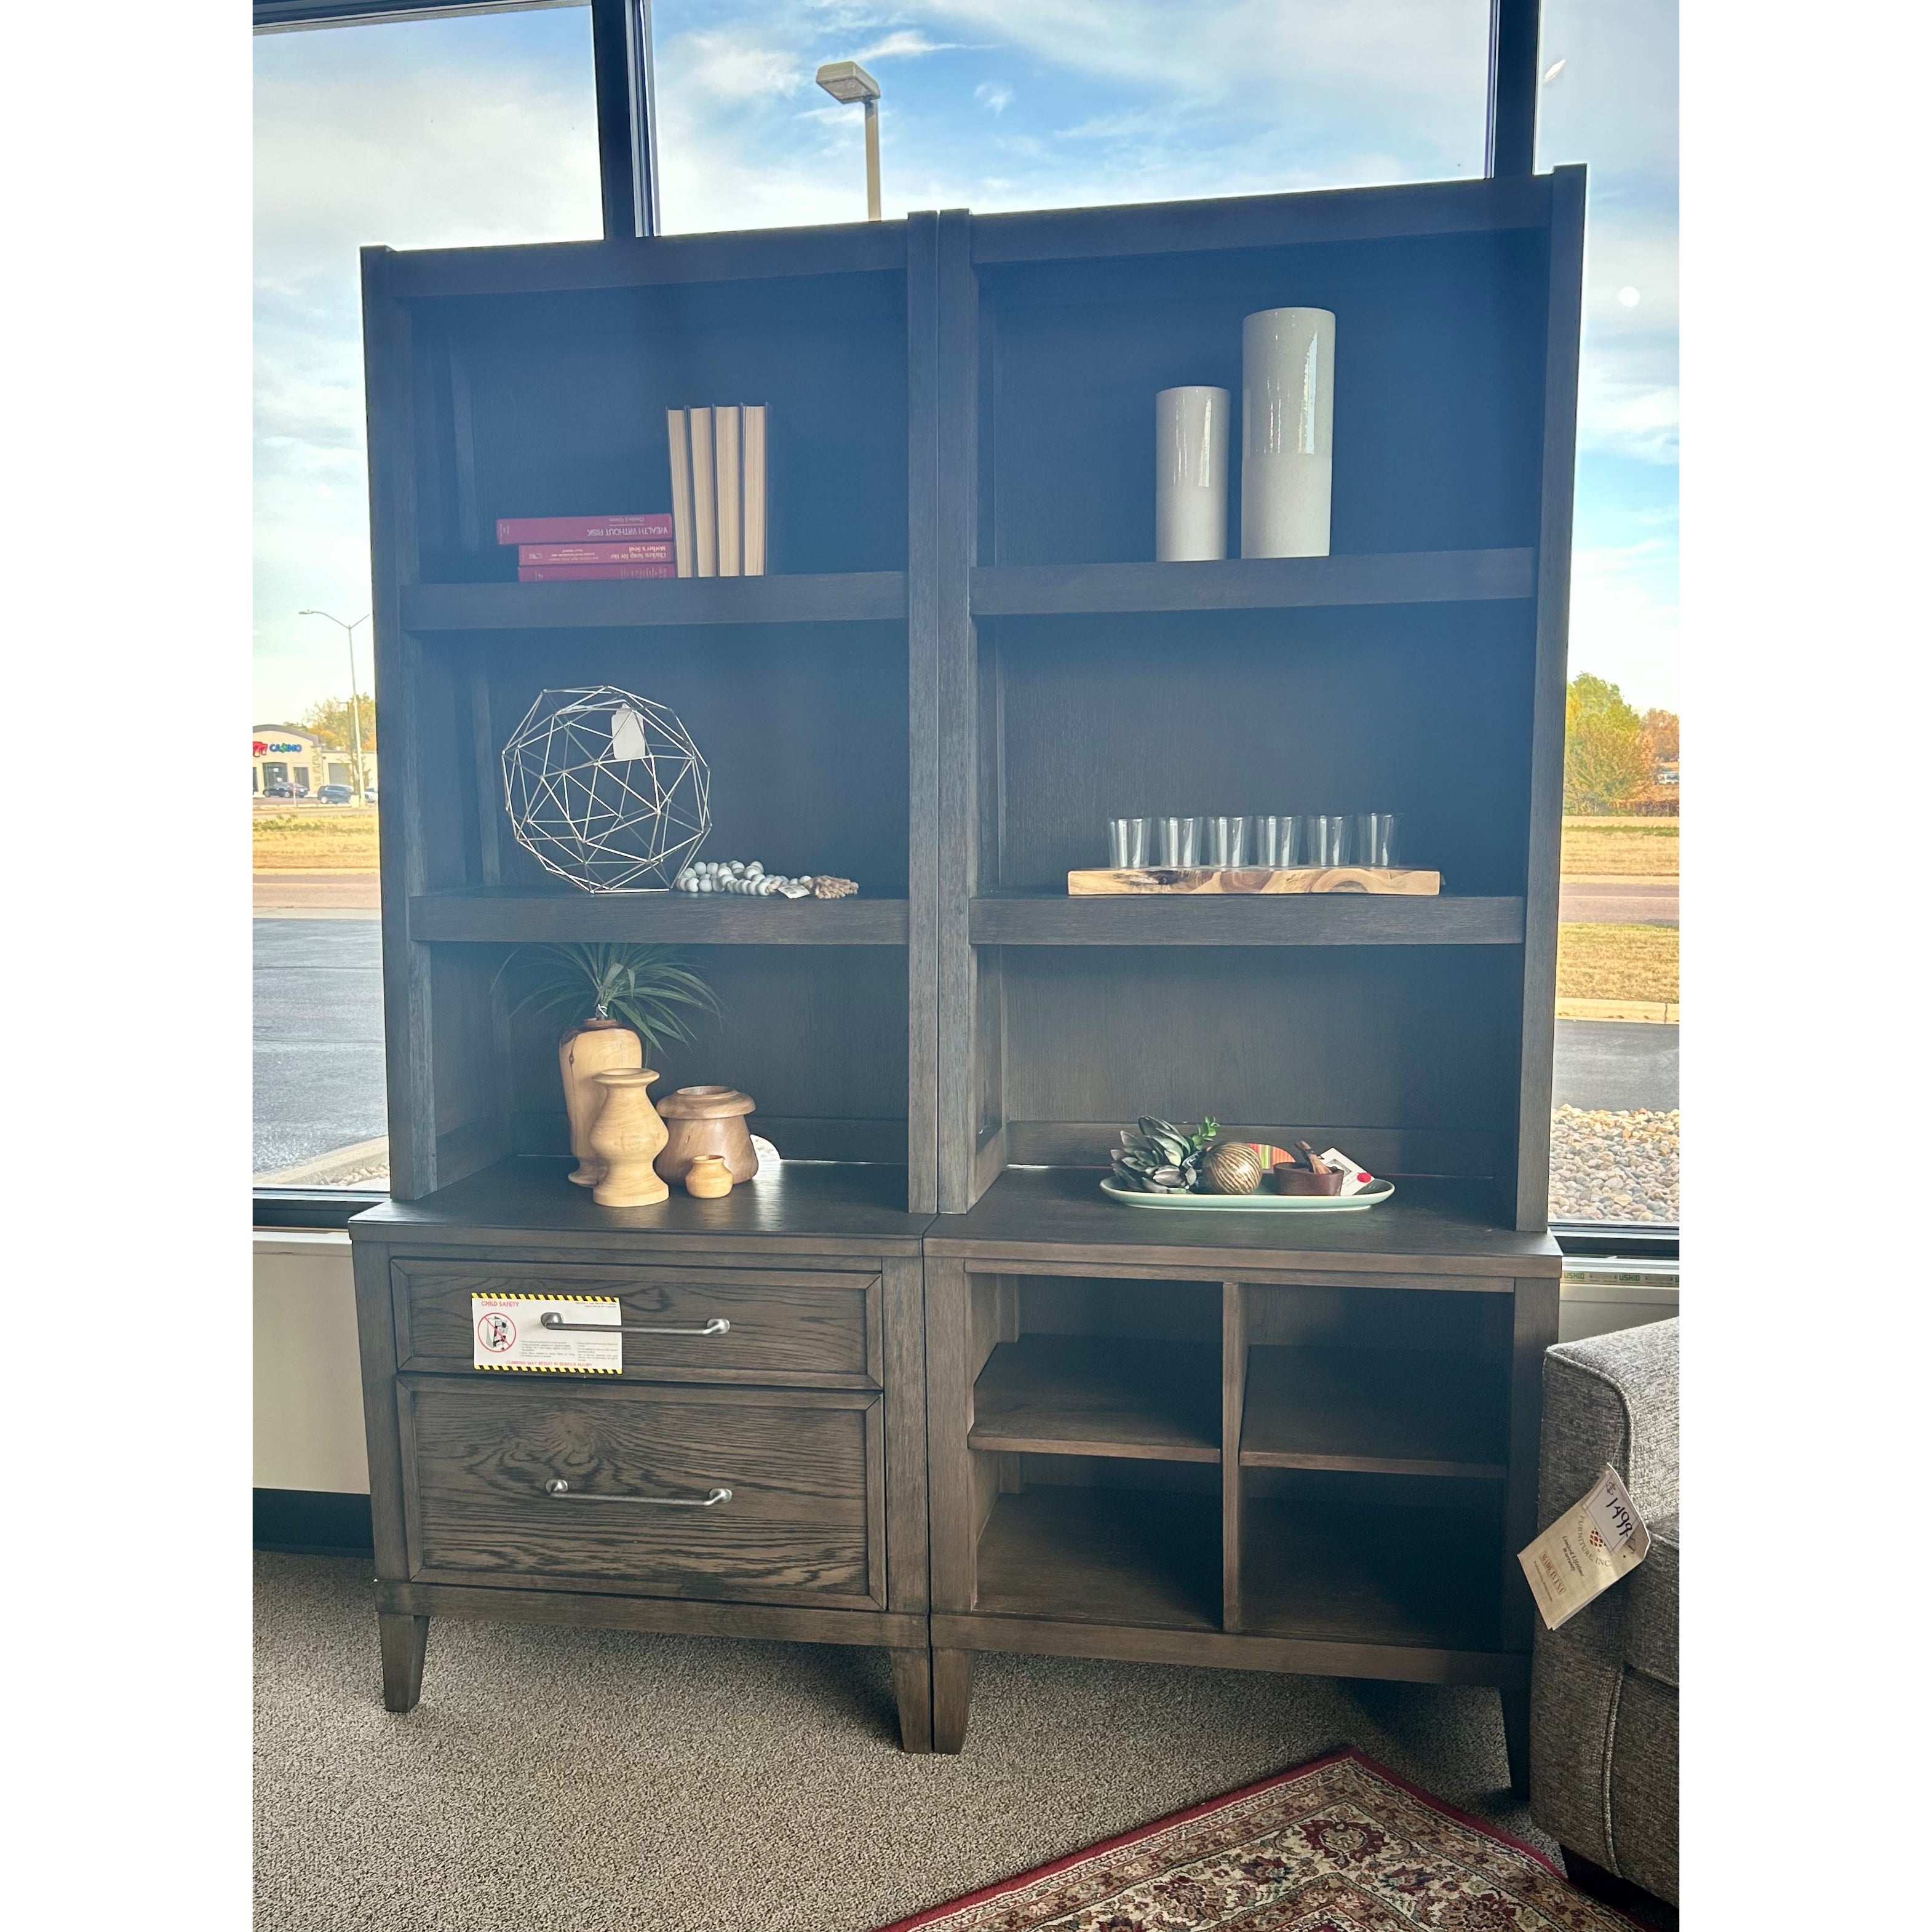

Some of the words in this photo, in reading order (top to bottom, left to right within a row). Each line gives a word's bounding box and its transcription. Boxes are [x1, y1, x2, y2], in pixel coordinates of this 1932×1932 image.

[605, 528, 637, 536] WITHOUT
[1562, 1535, 1575, 1555] Limited
[1572, 1556, 1584, 1576] Lifetime
[1562, 1547, 1575, 1571] Warranty
